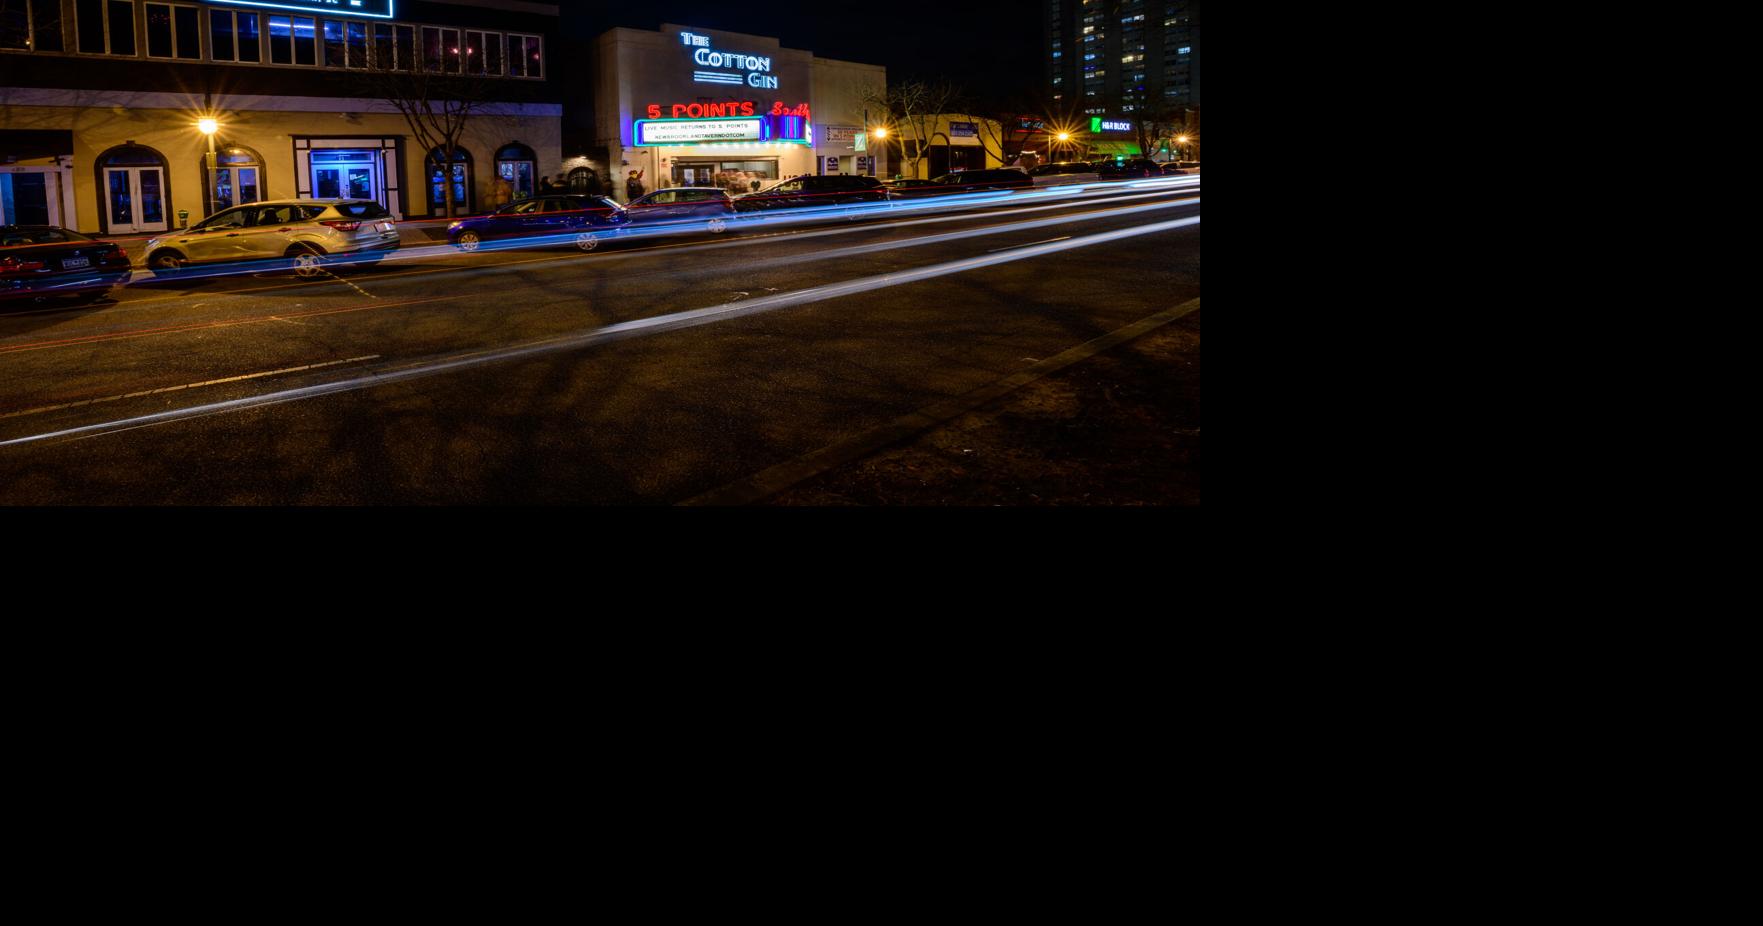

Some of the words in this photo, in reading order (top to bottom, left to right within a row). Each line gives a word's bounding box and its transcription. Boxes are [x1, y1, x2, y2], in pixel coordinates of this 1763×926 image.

[680, 32, 709, 47] THE
[694, 48, 770, 72] COTTON
[747, 72, 778, 89] GIN
[648, 104, 661, 119] 5
[672, 101, 754, 118] POINTS
[1114, 122, 1130, 131] BLOCK
